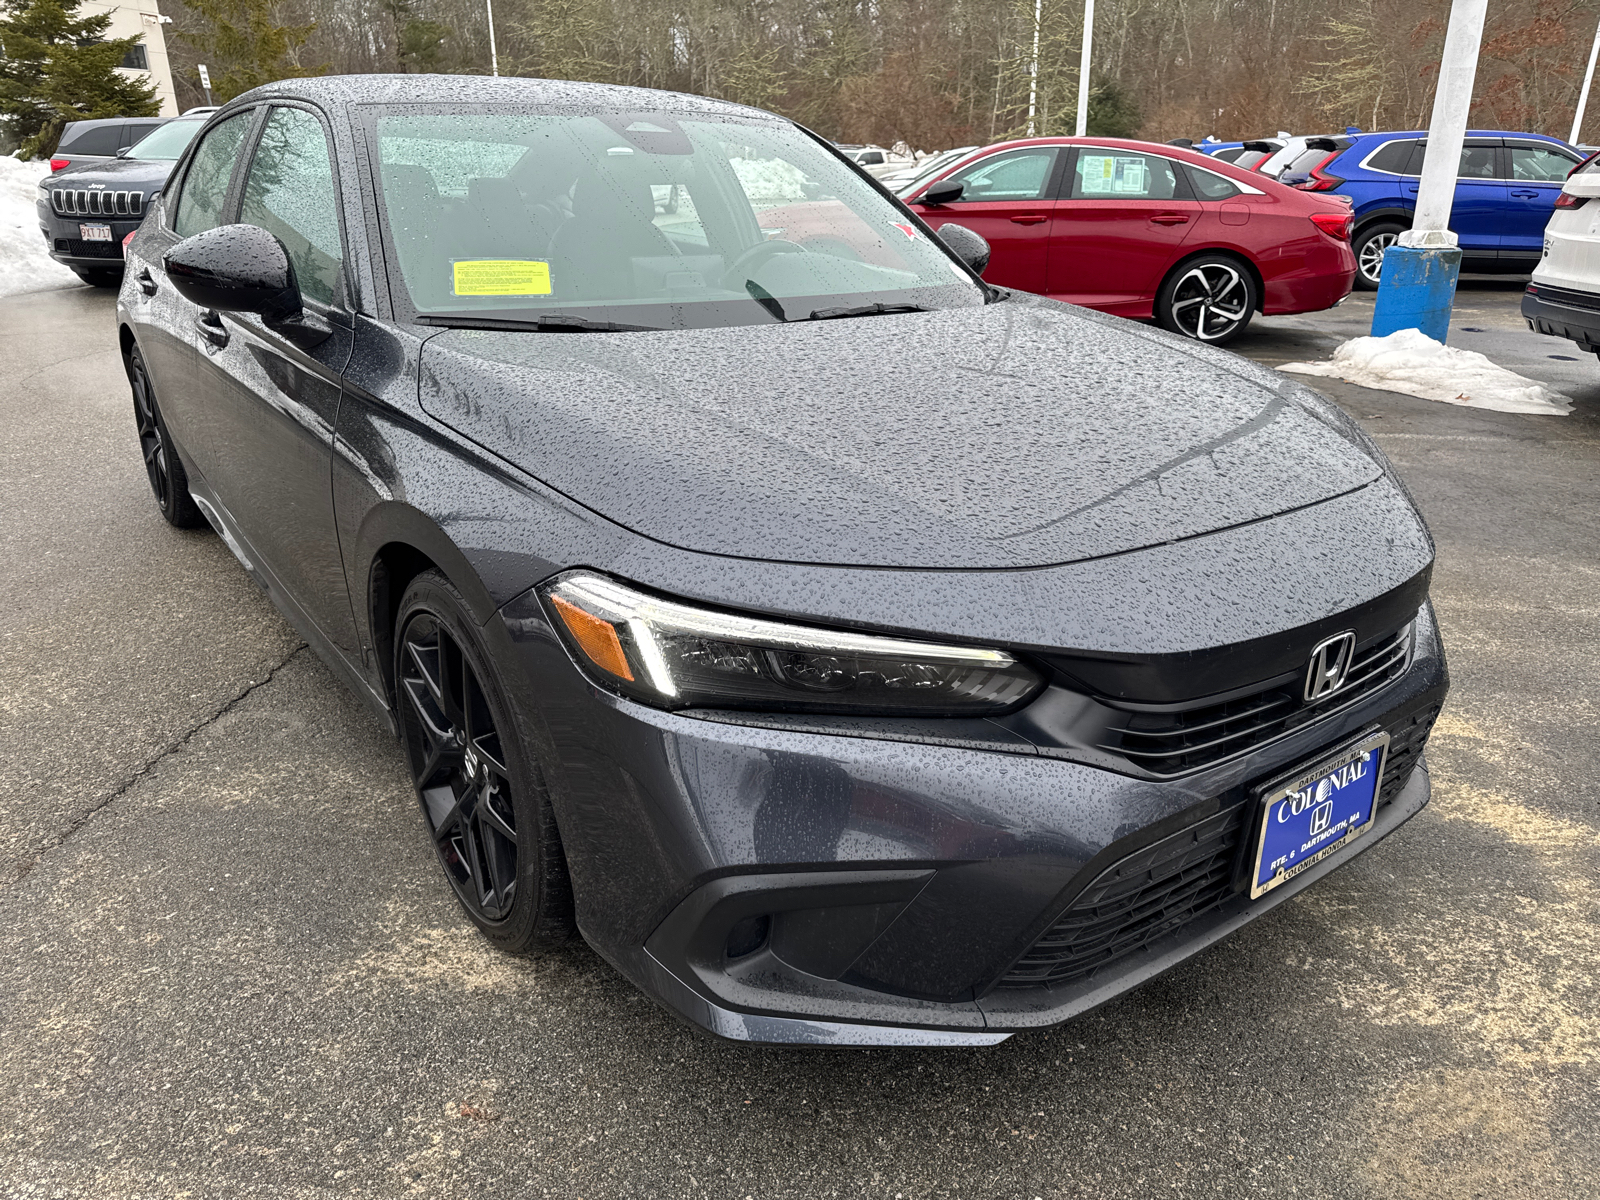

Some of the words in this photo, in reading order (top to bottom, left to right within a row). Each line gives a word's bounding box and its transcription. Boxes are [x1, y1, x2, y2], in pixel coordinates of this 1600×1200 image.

[1277, 762, 1367, 823] COLONIAL
[1270, 855, 1288, 870] RTE.
[1290, 850, 1296, 858] 6
[1300, 819, 1348, 853] DARTMOUTH,
[1349, 811, 1360, 824] MA
[1283, 855, 1320, 881] COLONIAL
[1321, 837, 1346, 859] HONDA
